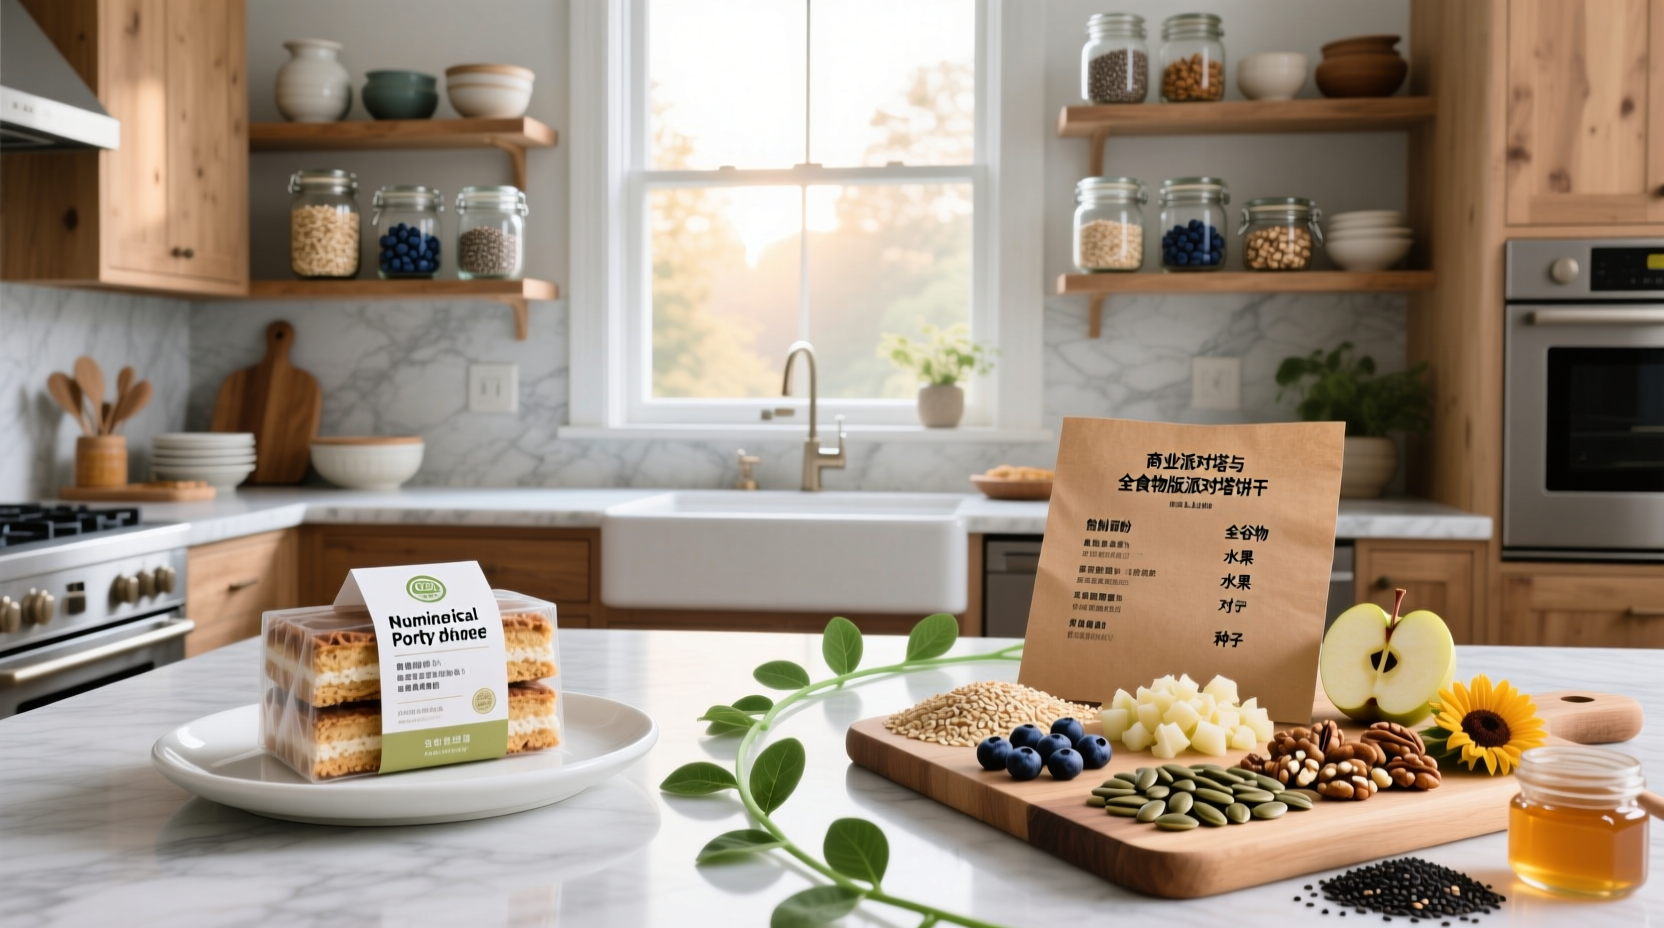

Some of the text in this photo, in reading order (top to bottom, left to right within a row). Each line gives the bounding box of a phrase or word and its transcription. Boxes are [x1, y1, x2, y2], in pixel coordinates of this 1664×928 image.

[1146, 452, 1245, 473] 商业派对塔与
[1118, 473, 1269, 497] 全食物版派对塔饼干
[1225, 524, 1269, 542] 全谷物
[1223, 548, 1254, 566] 水果
[1220, 573, 1252, 591] 水果
[1213, 630, 1244, 648] 种子
